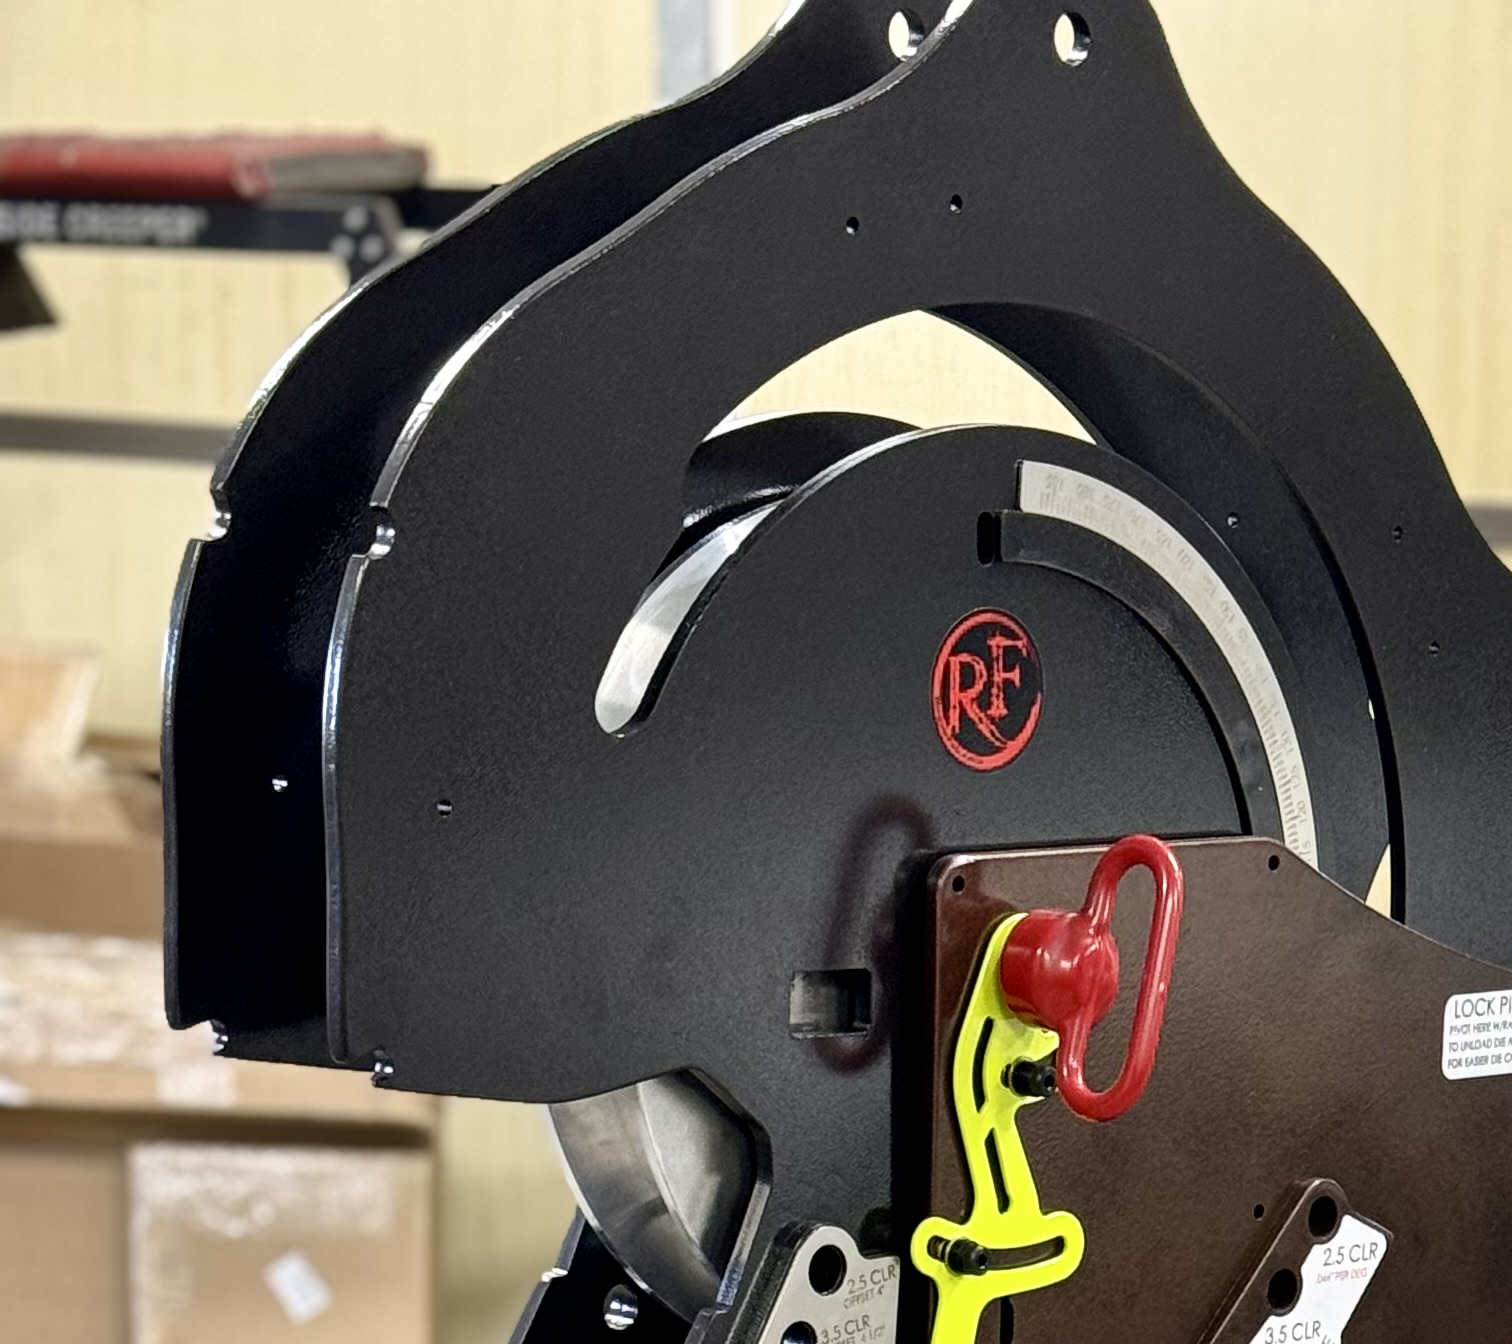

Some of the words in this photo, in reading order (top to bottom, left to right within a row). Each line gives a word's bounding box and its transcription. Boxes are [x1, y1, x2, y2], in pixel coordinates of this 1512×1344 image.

[1454, 997, 1496, 1019] LOCK
[1323, 1246, 1345, 1267] 2.5
[1349, 1242, 1378, 1262] CLR
[846, 1274, 867, 1295] 2.5
[870, 1264, 896, 1285] CLR
[821, 1325, 842, 1344] 3.5
[844, 1314, 871, 1335] CLR
[1264, 1325, 1287, 1344] 3.5
[1292, 1320, 1321, 1341] CLR
